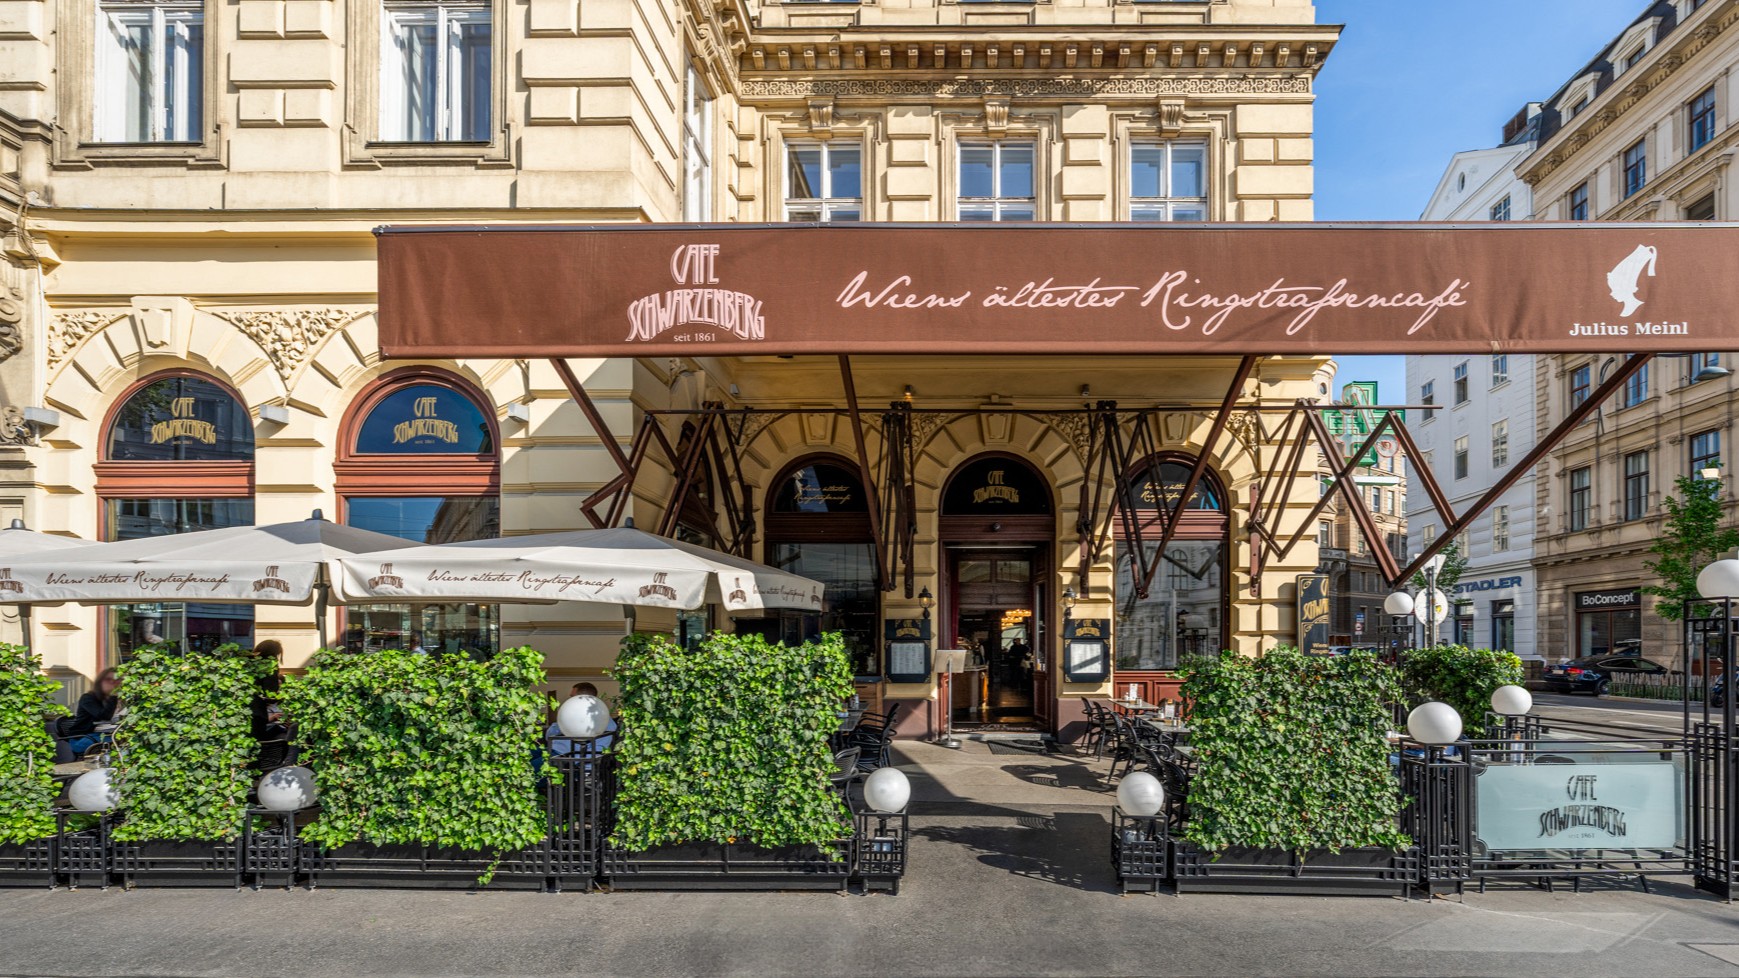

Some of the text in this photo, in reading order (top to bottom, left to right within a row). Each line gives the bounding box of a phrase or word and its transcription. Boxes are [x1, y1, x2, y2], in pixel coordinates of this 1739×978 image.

[670, 244, 720, 284] CAFE
[836, 271, 971, 308] Wiens
[982, 277, 1140, 308] ältestes
[625, 289, 765, 341] SCHWARZENBERG
[674, 333, 716, 342] seit 1861
[1569, 321, 1689, 336] Julius Meinl
[171, 397, 196, 417] CAFE
[414, 397, 438, 417] CAFE
[149, 419, 217, 445] SCHWARZENBERG
[391, 419, 459, 444] SCHWARZENBERG
[46, 572, 85, 585] Wiens
[427, 569, 467, 581] Wiens
[1453, 575, 1522, 594] STADLER
[1582, 592, 1635, 606] BoConcept
[1566, 775, 1597, 801] CAFE
[1537, 804, 1627, 838] SCHWARZENBERG
